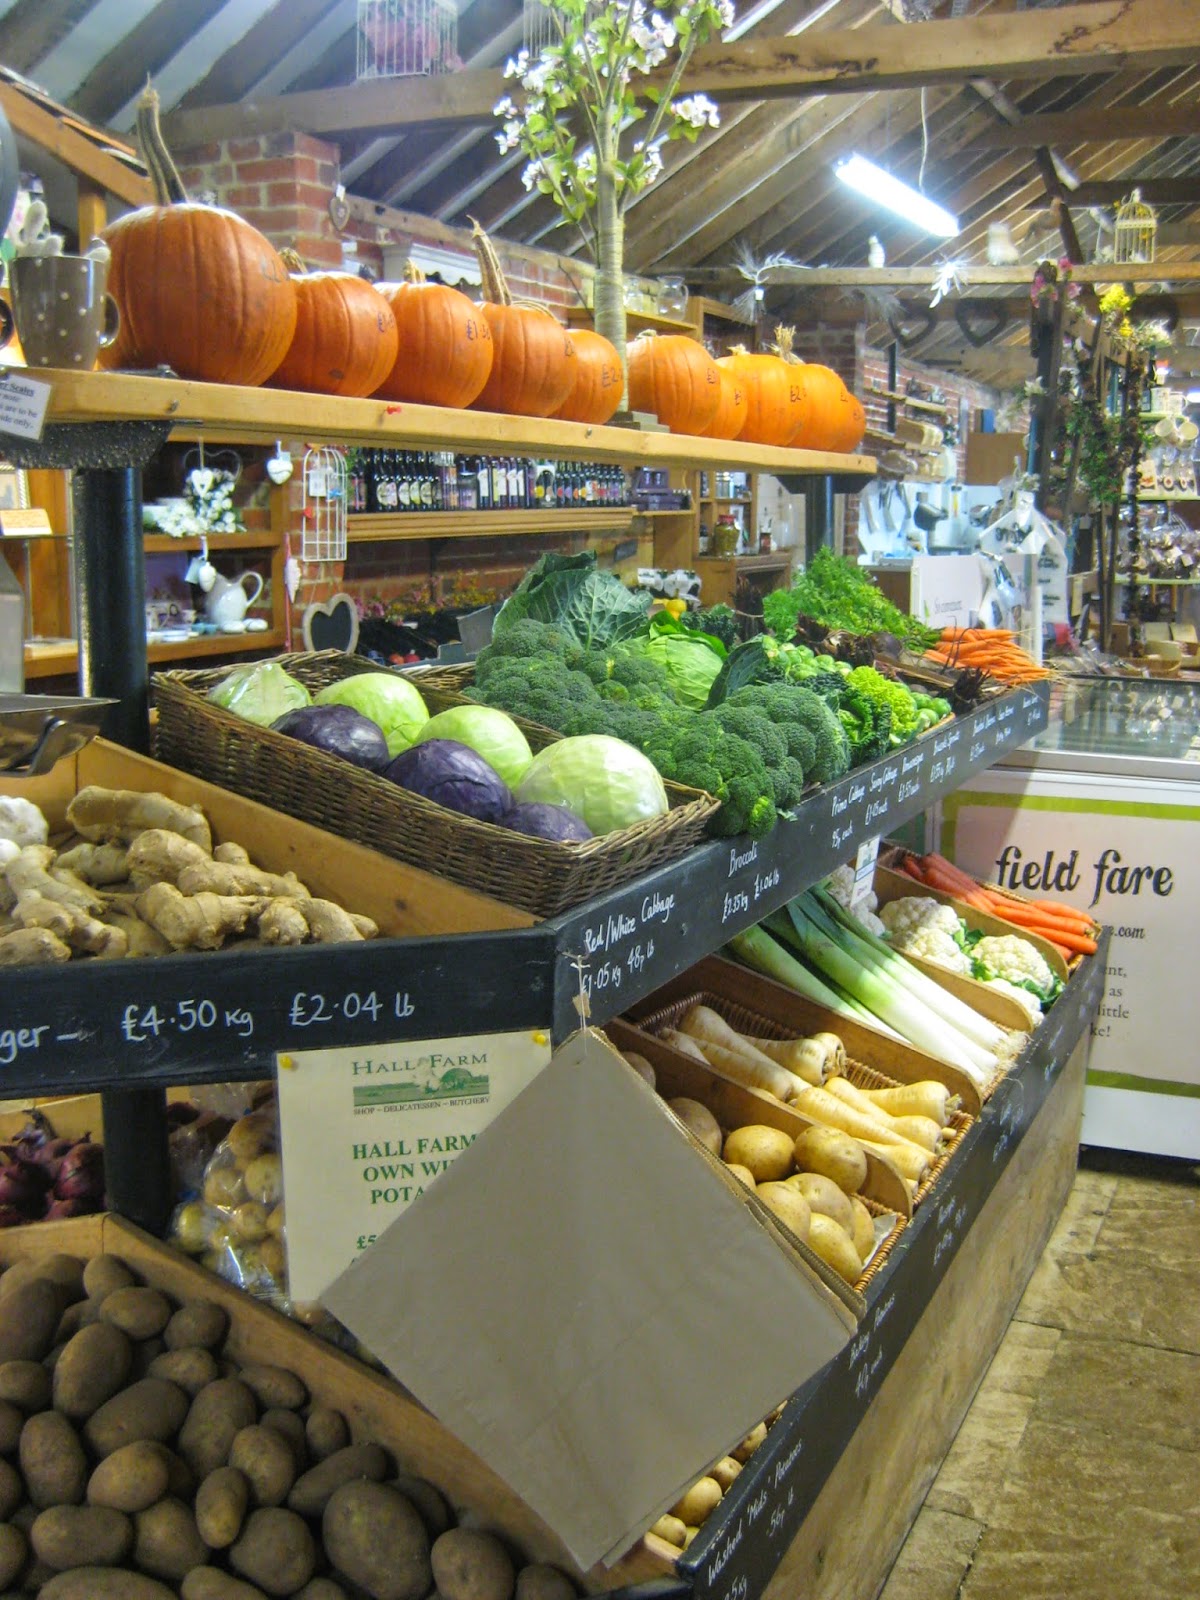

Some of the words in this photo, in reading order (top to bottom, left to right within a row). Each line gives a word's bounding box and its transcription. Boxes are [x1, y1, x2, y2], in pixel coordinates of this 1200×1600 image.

[728, 841, 758, 878] Broccoli
[995, 845, 1081, 893] field
[1088, 849, 1174, 910] fare
[641, 892, 675, 924] Cabbage
[1109, 987, 1123, 997] as
[121, 1000, 218, 1042] £4.50
[289, 991, 384, 1027] £2.04
[395, 991, 416, 1017] lb
[353, 1107, 376, 1116] SHOP
[383, 1101, 441, 1114] DELICATESSEN
[449, 1095, 490, 1108] BUTCHERY
[352, 1140, 412, 1160] HALL
[363, 1163, 415, 1183] OWN
[708, 1518, 743, 1587] Washed
